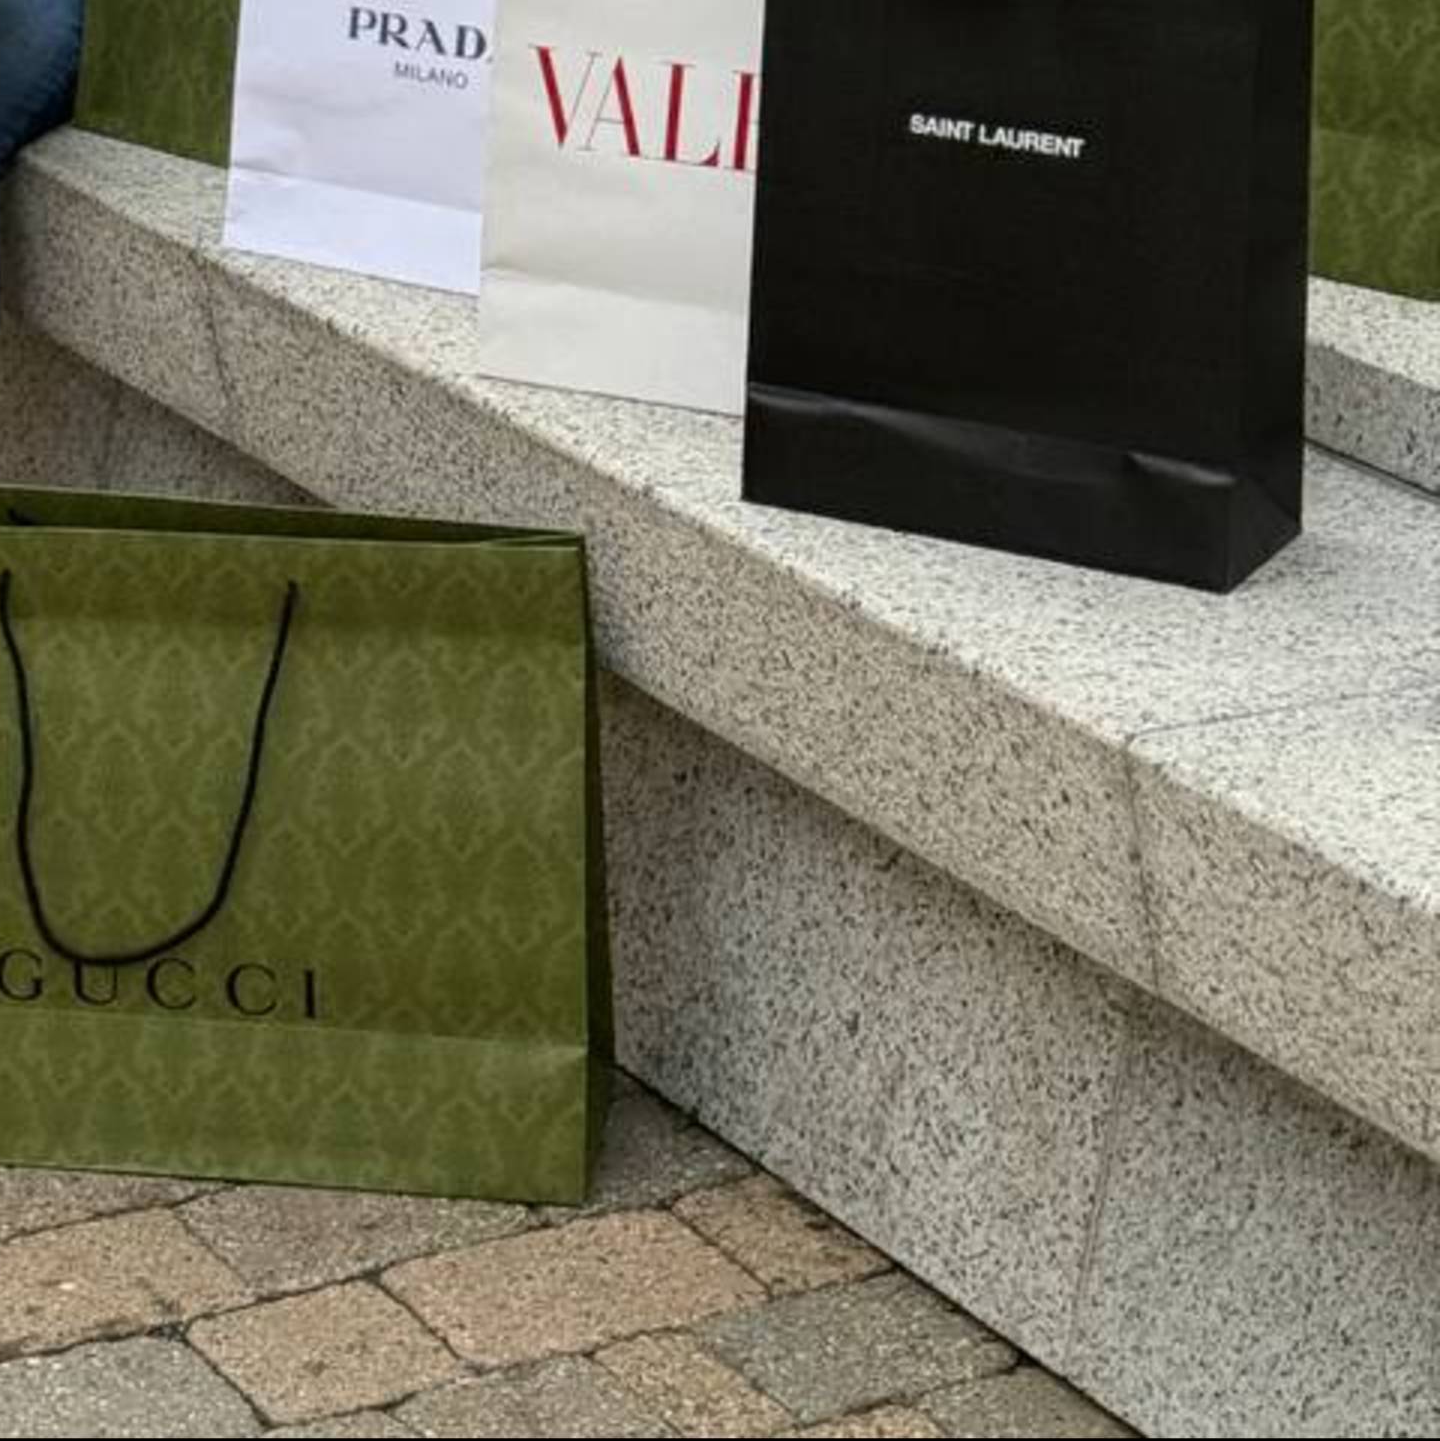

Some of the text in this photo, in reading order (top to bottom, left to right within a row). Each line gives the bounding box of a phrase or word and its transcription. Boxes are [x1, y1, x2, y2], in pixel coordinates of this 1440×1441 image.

[349, 6, 494, 63] PRAD
[394, 61, 469, 89] MILANO
[910, 113, 1086, 159] SAINT LAURENT
